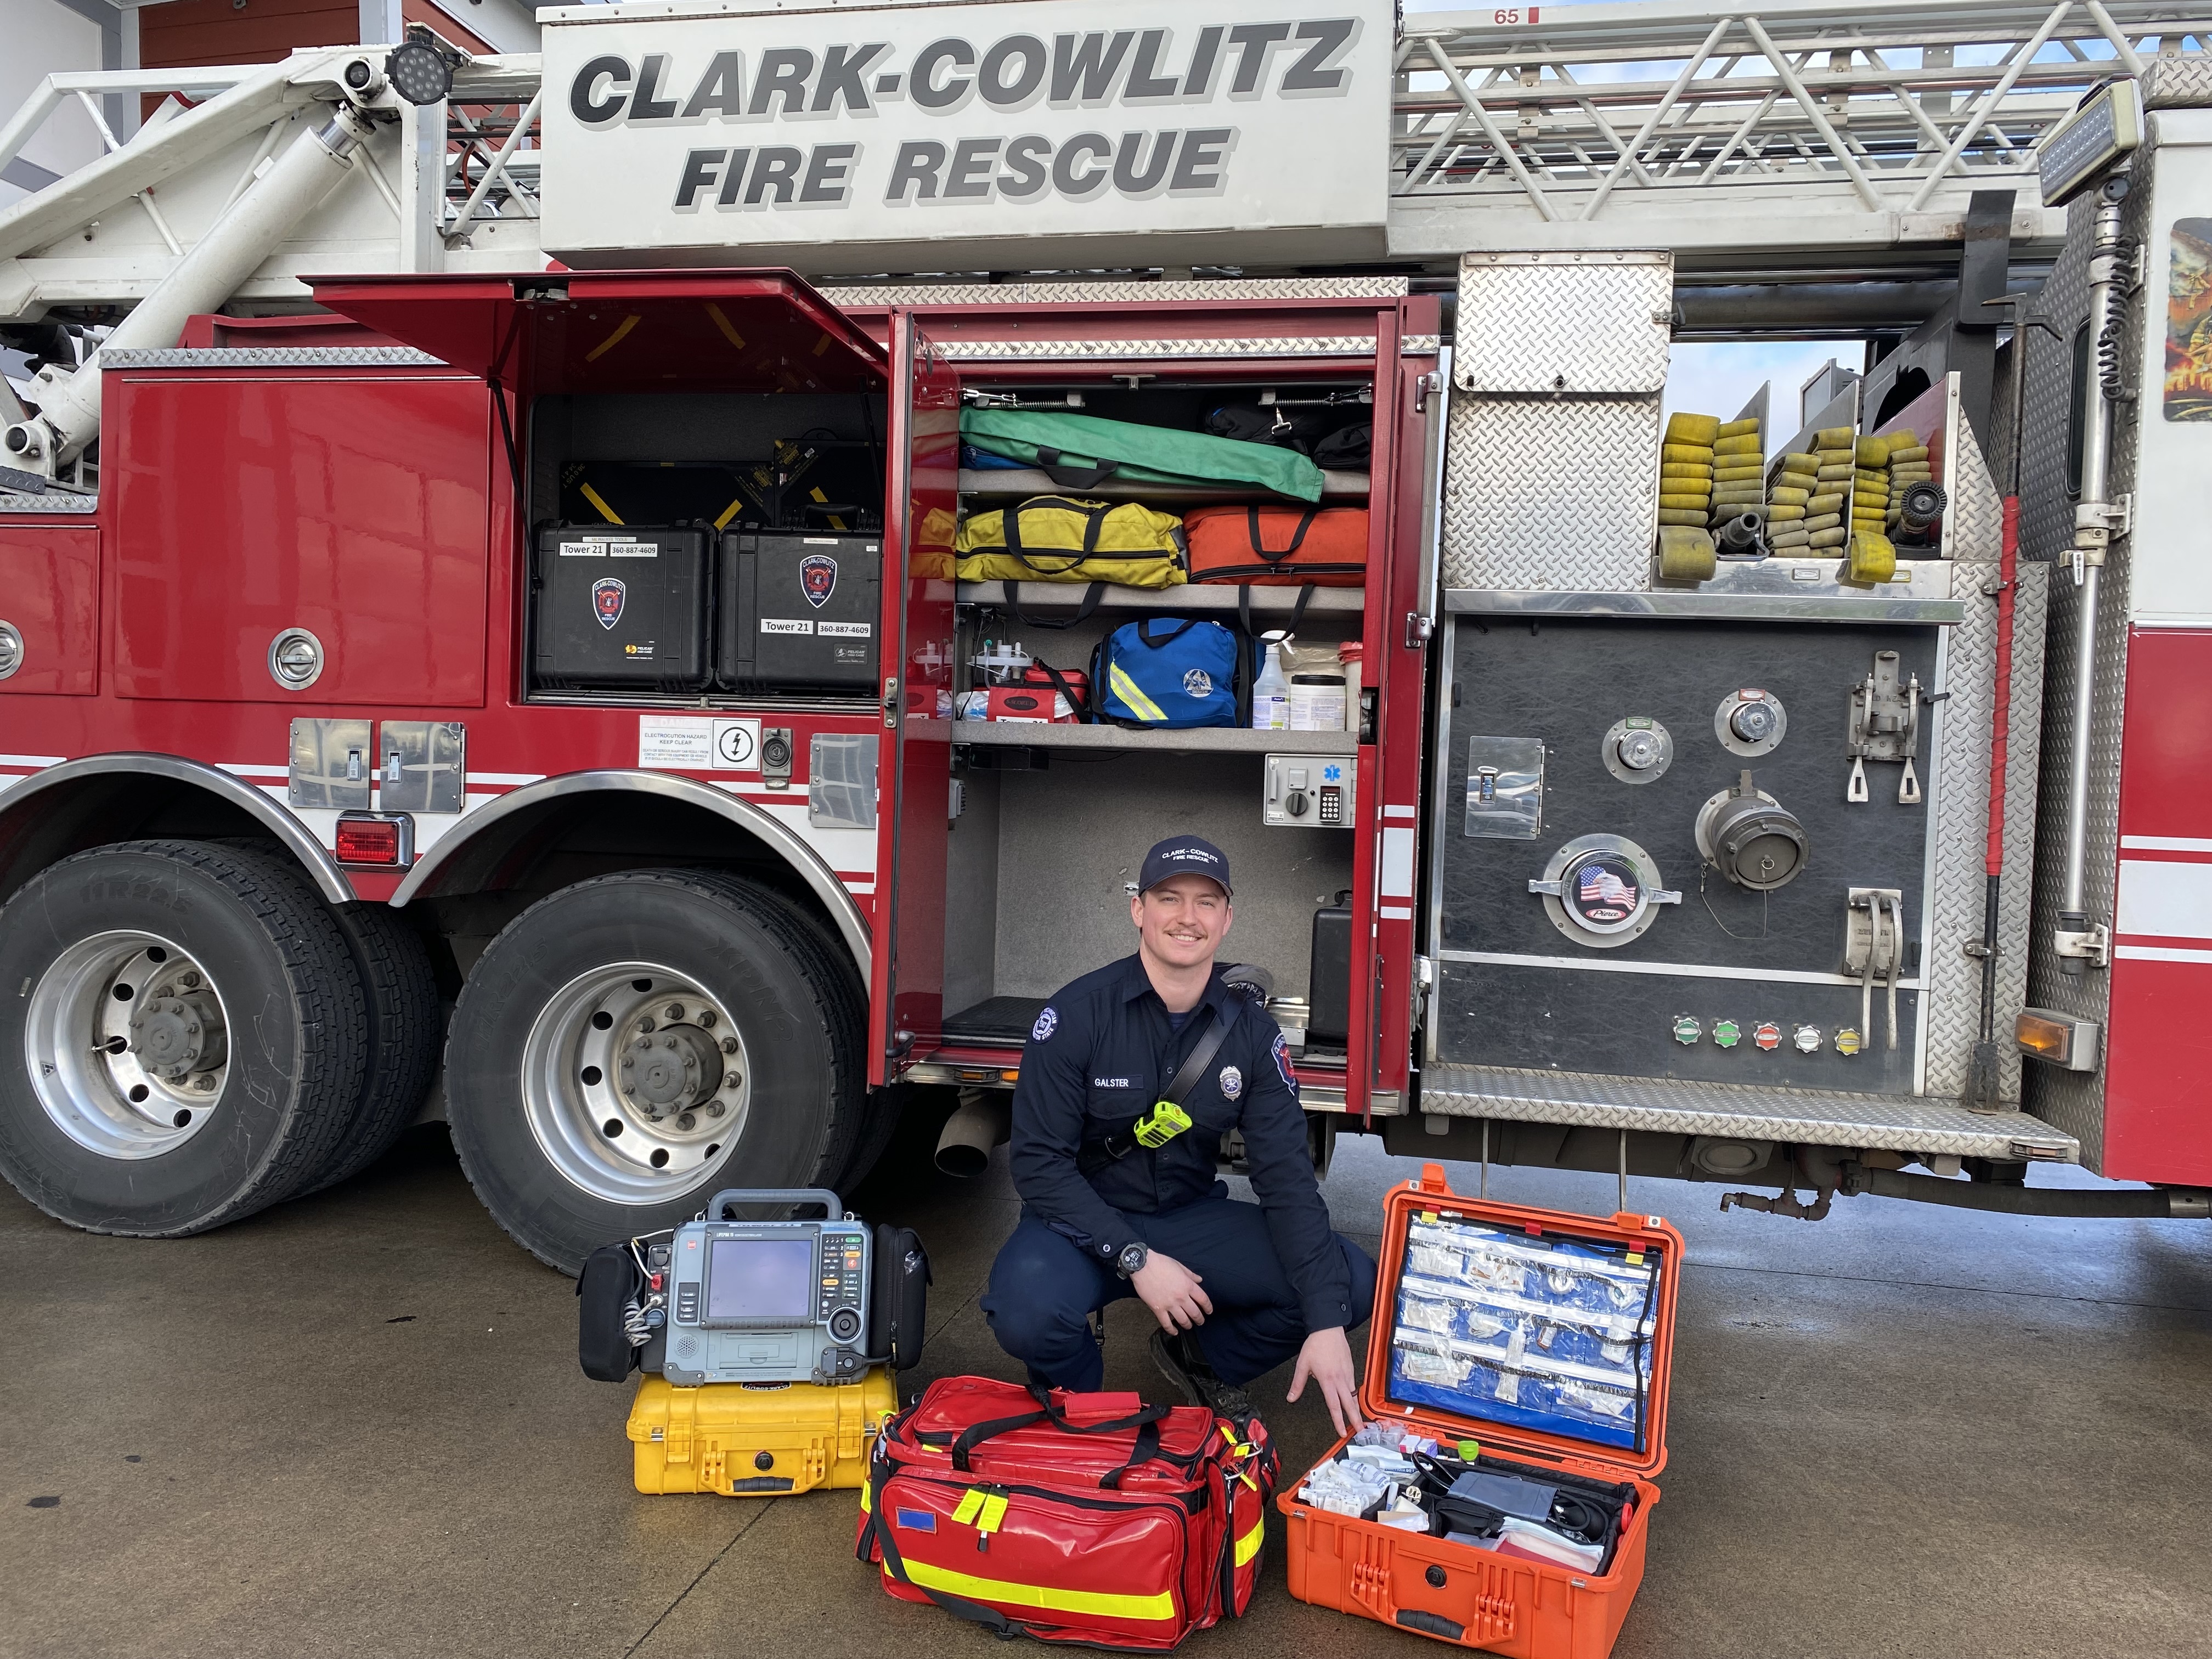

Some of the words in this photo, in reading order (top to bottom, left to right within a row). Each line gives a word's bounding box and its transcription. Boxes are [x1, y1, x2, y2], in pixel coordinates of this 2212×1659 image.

[1494, 9, 1519, 24] 65
[569, 18, 1364, 129] CLARK-COWLITZ
[671, 142, 864, 213] FIRE
[884, 126, 1240, 207] RESCUE
[564, 545, 590, 554] Tower
[592, 545, 602, 554] 21
[803, 557, 834, 569] CLARK-COWLITZ
[595, 580, 623, 591] CLARK-COWLITZ
[765, 622, 794, 631] Tower
[797, 623, 809, 631] 21
[820, 625, 868, 634] 360-887-4609
[1186, 855, 1209, 863] RESCUE
[1042, 1027, 1054, 1040] STATE
[1094, 1078, 1128, 1087] GALSTER
